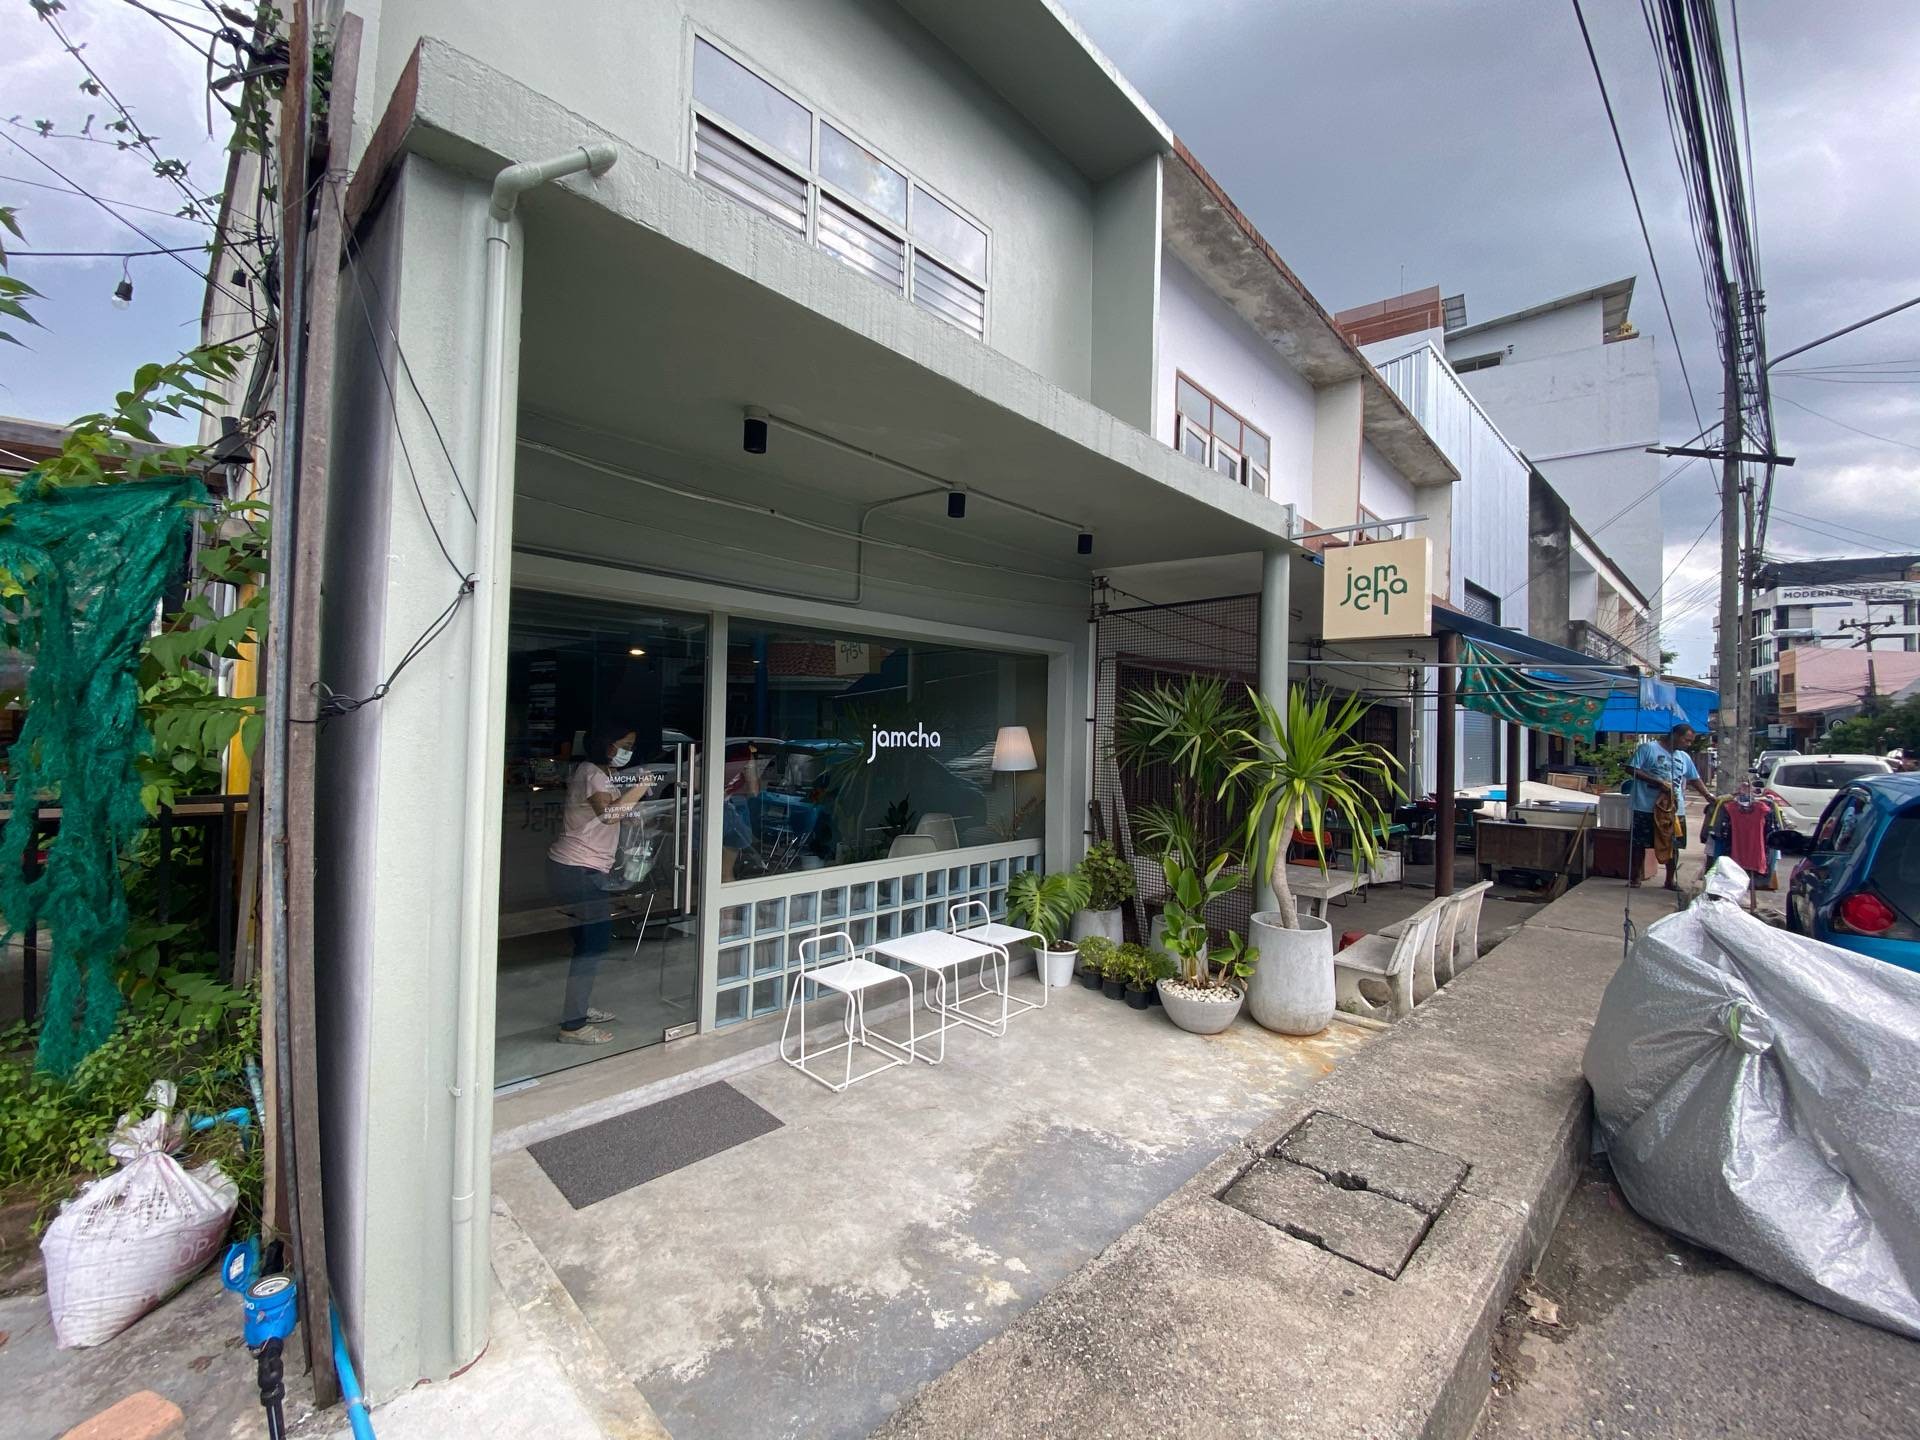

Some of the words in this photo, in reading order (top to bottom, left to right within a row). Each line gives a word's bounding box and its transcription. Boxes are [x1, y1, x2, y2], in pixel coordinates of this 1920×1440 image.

[1783, 589, 1834, 599] MODERN
[866, 721, 941, 765] jamcha
[604, 775, 637, 784] JAMCHA
[638, 774, 665, 782] HATYAI
